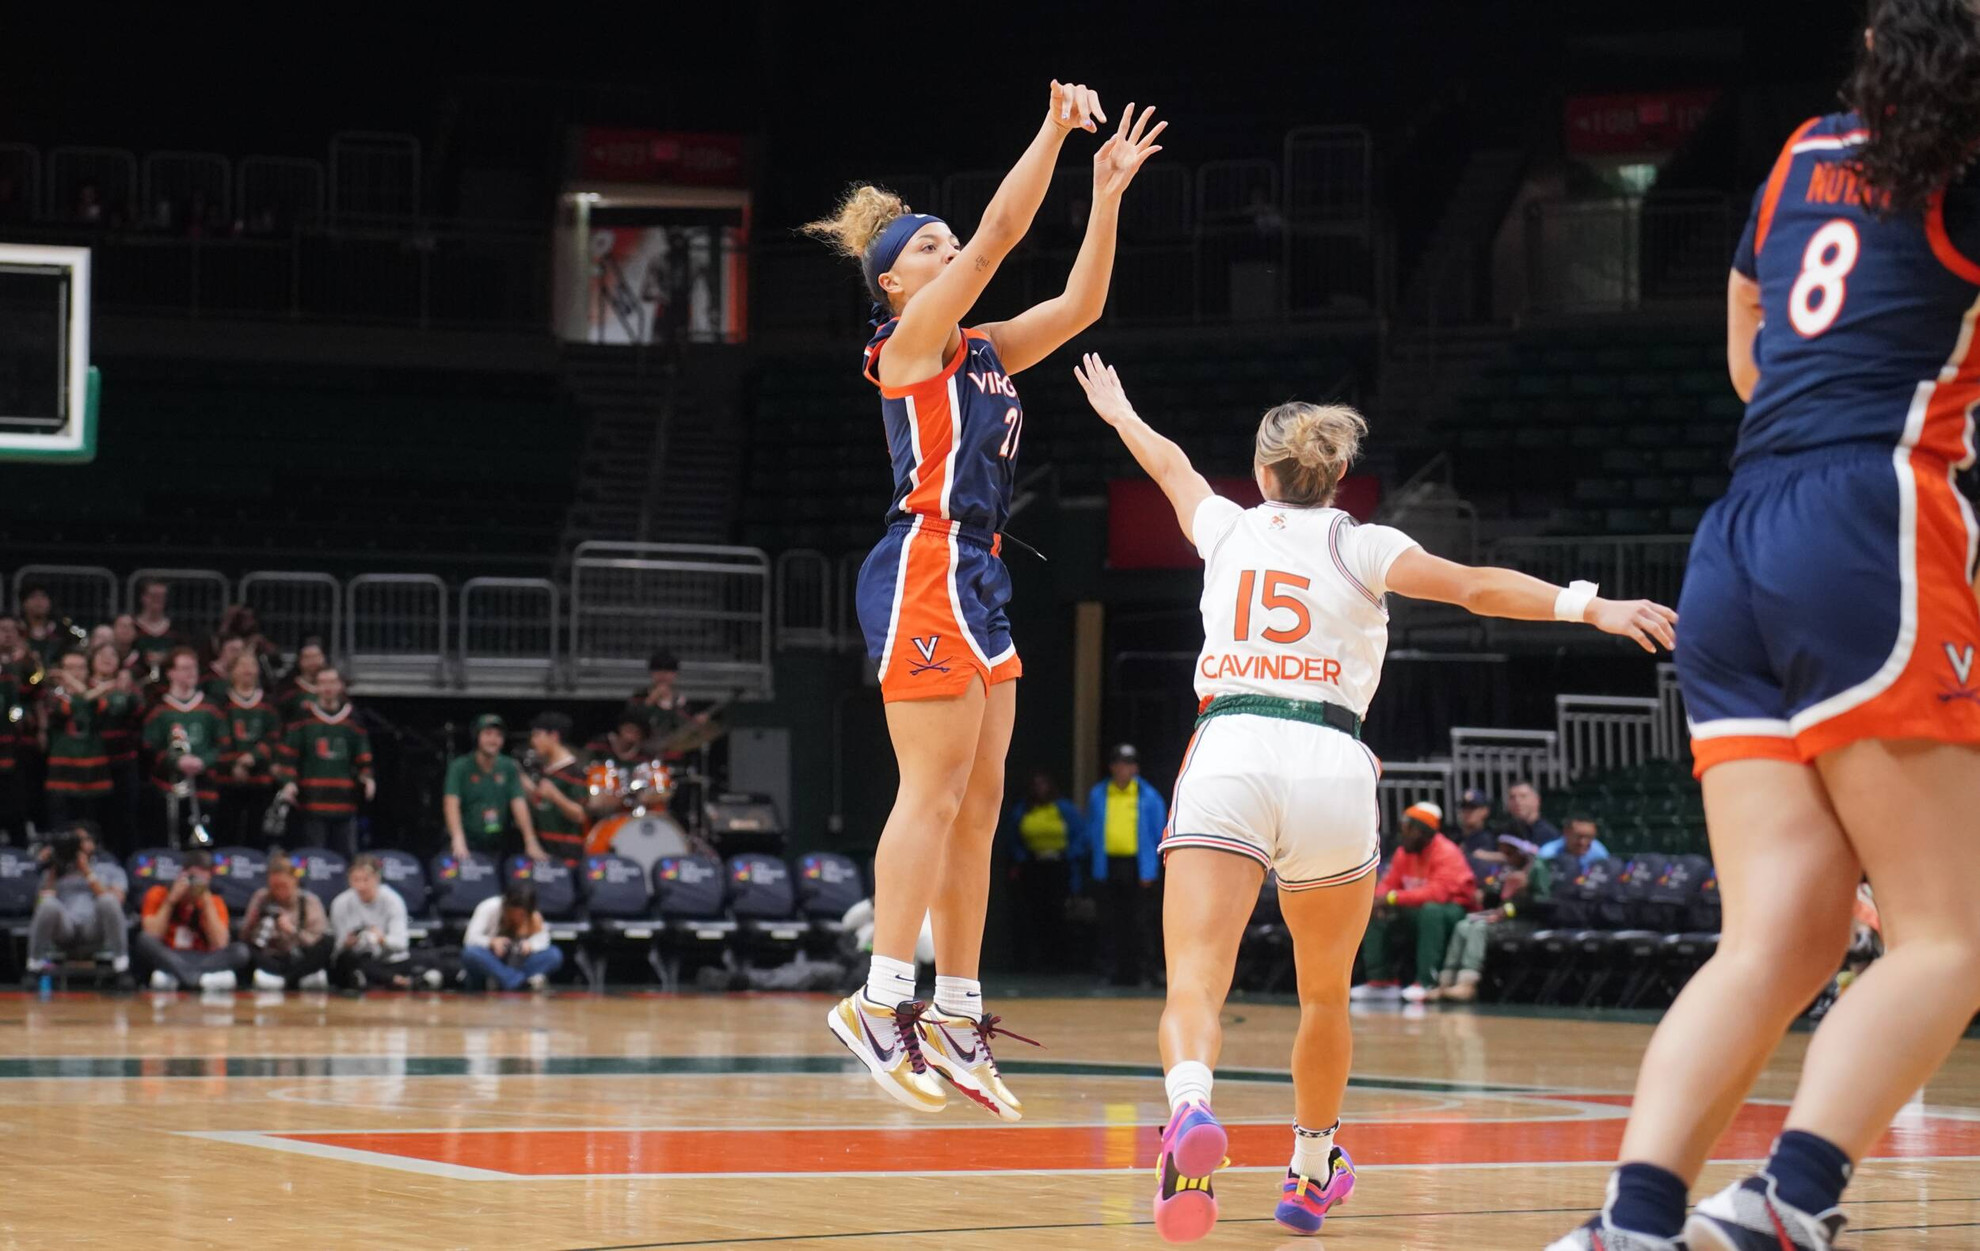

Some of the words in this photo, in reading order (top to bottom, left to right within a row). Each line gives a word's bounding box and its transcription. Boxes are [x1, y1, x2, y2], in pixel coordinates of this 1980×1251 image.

[1787, 217, 1861, 340] 8
[1234, 569, 1312, 644] 15
[1201, 654, 1342, 686] CAVINDER
